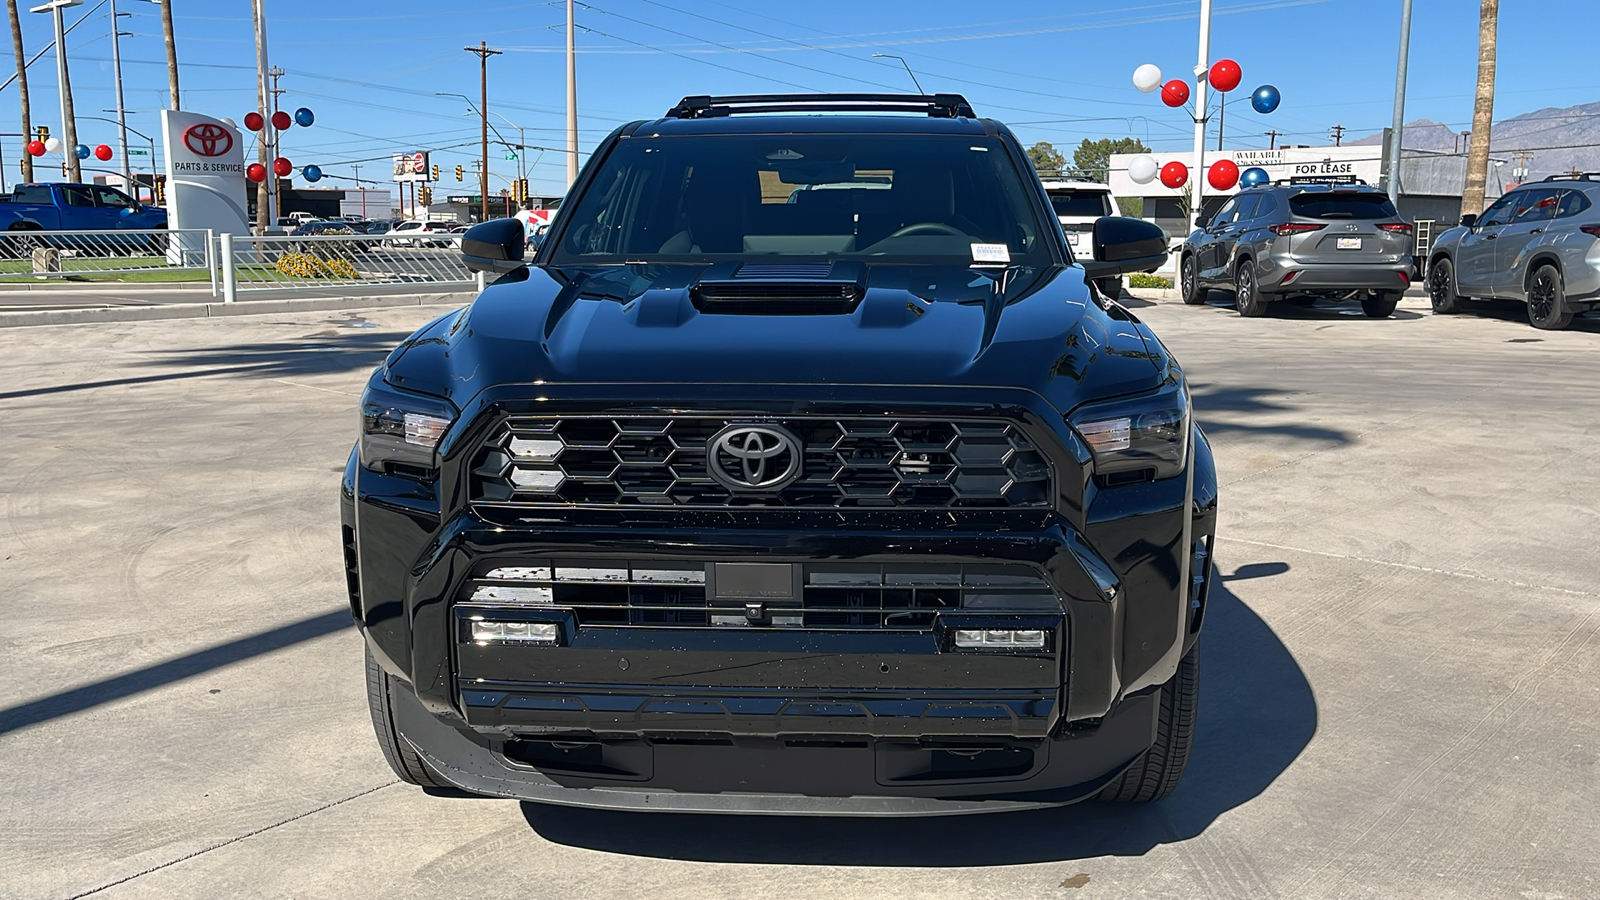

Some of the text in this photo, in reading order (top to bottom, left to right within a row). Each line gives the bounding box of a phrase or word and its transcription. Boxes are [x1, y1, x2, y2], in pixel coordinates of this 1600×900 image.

[1235, 151, 1283, 159] AVAILABLE
[175, 162, 242, 173] PARTS & SERVICE
[1295, 163, 1352, 174] FOR LEASE
